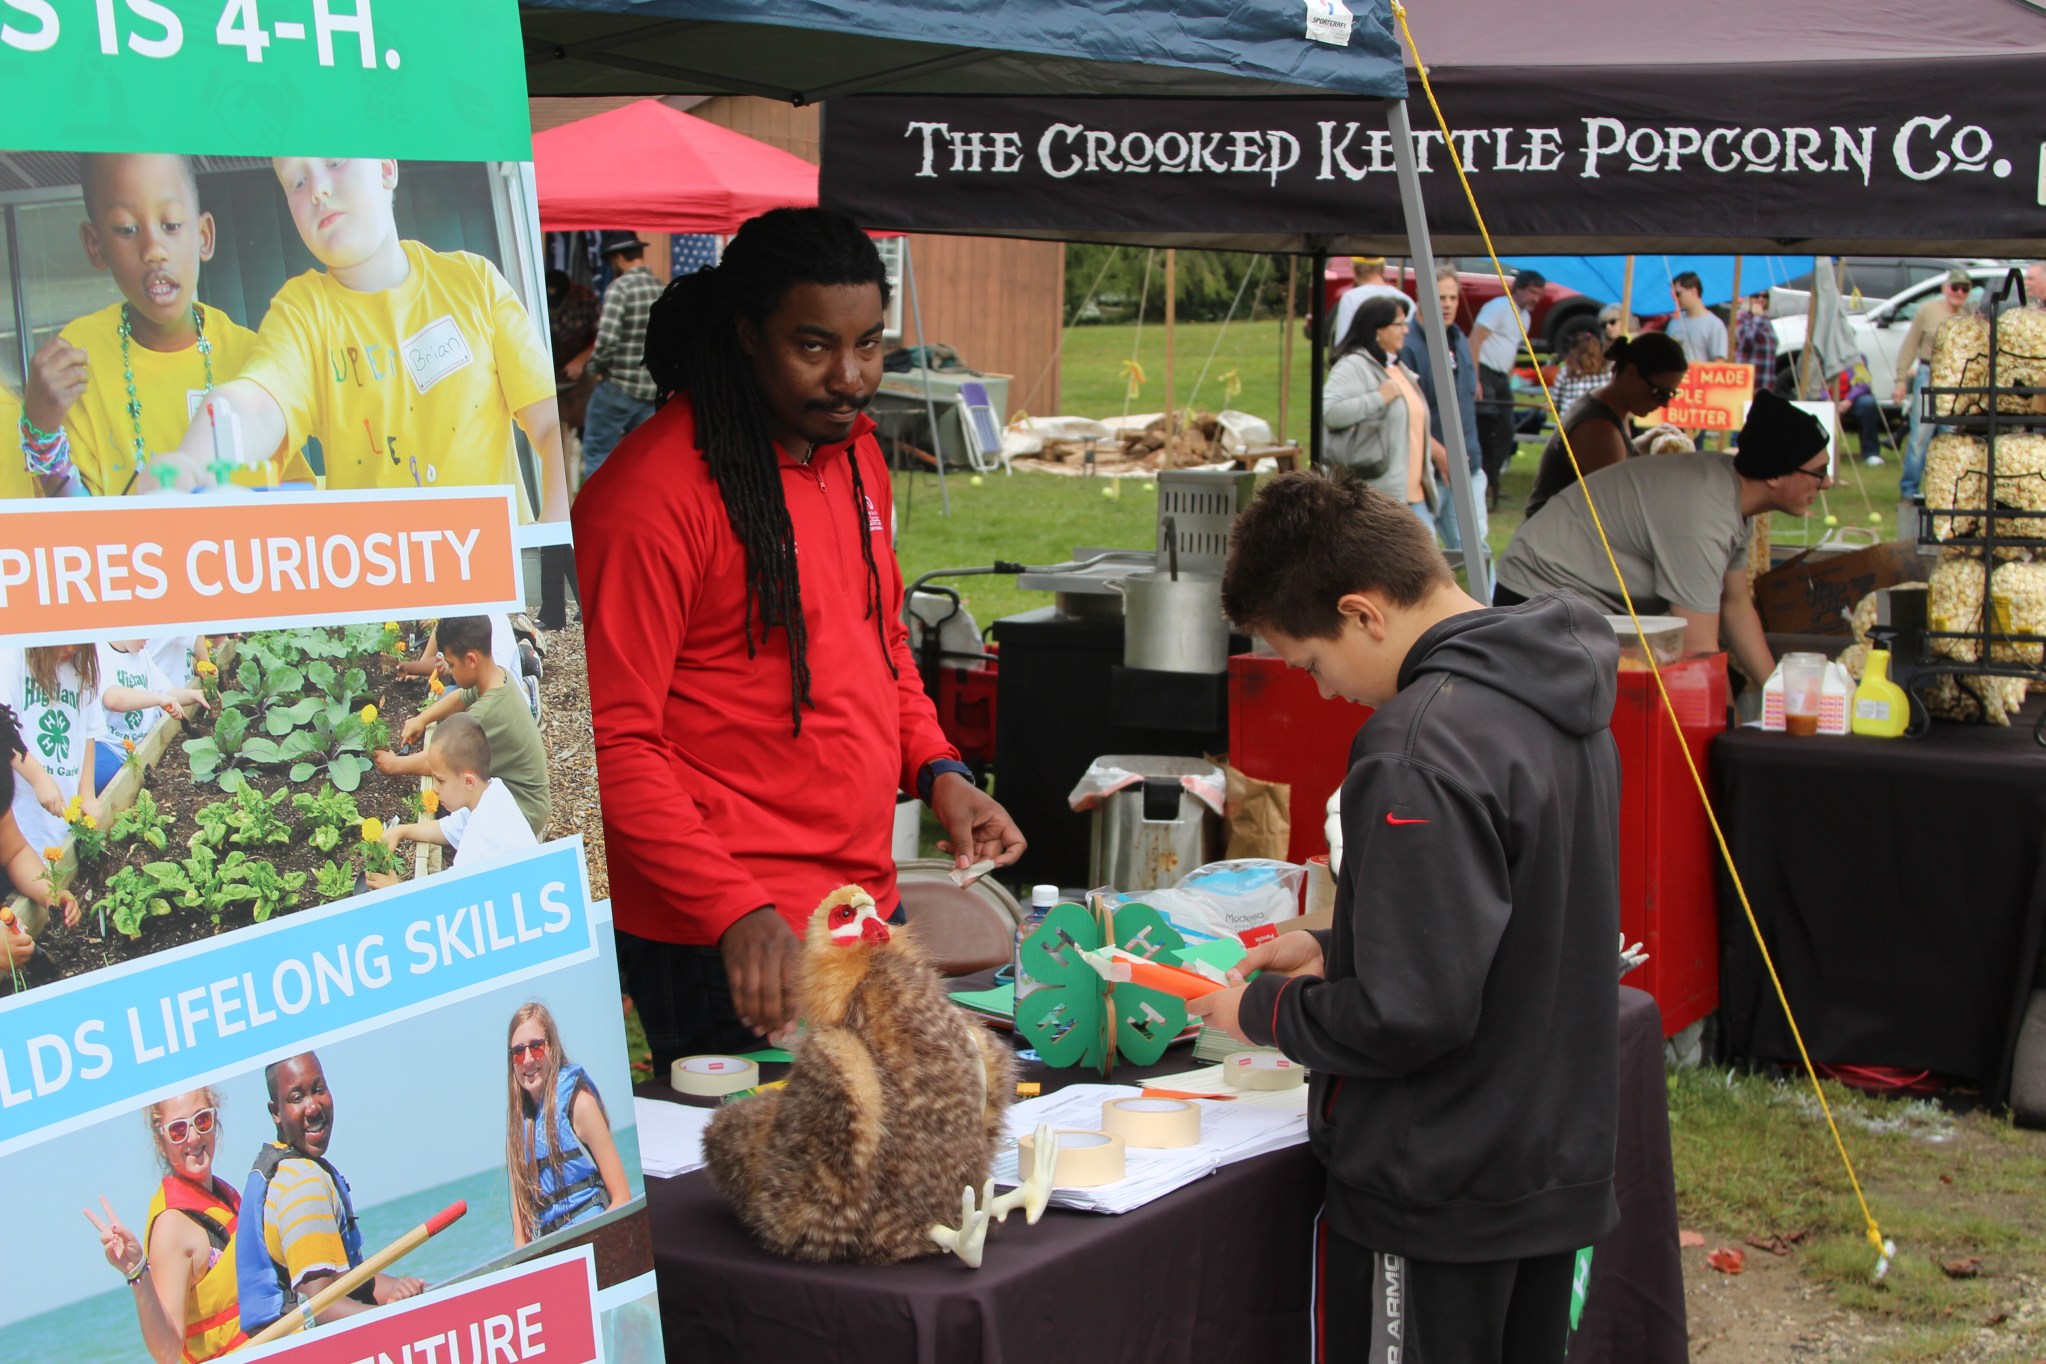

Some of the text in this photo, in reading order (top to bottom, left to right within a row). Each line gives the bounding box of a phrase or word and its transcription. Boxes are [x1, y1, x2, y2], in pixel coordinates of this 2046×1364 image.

[95, 0, 184, 58] IS
[216, 0, 401, 70] 4-H.
[1312, 17, 1346, 29] SPORTCRAFT
[905, 114, 2012, 187] THE CROOKED KETTLE POPCORN CO.
[409, 337, 461, 371] Brian
[1675, 388, 1704, 404] PLE
[1701, 369, 1745, 385] MADE
[1667, 407, 1727, 426] BUTTER
[0, 529, 481, 608] PIRES CURIOSITY
[1040, 927, 1076, 967] H
[1124, 924, 1165, 959] H
[0, 881, 571, 1109] LDS LIFELONG SKILLS
[1036, 1003, 1078, 1044] H
[1126, 1001, 1168, 1041] H
[350, 1302, 546, 1364] TURE
